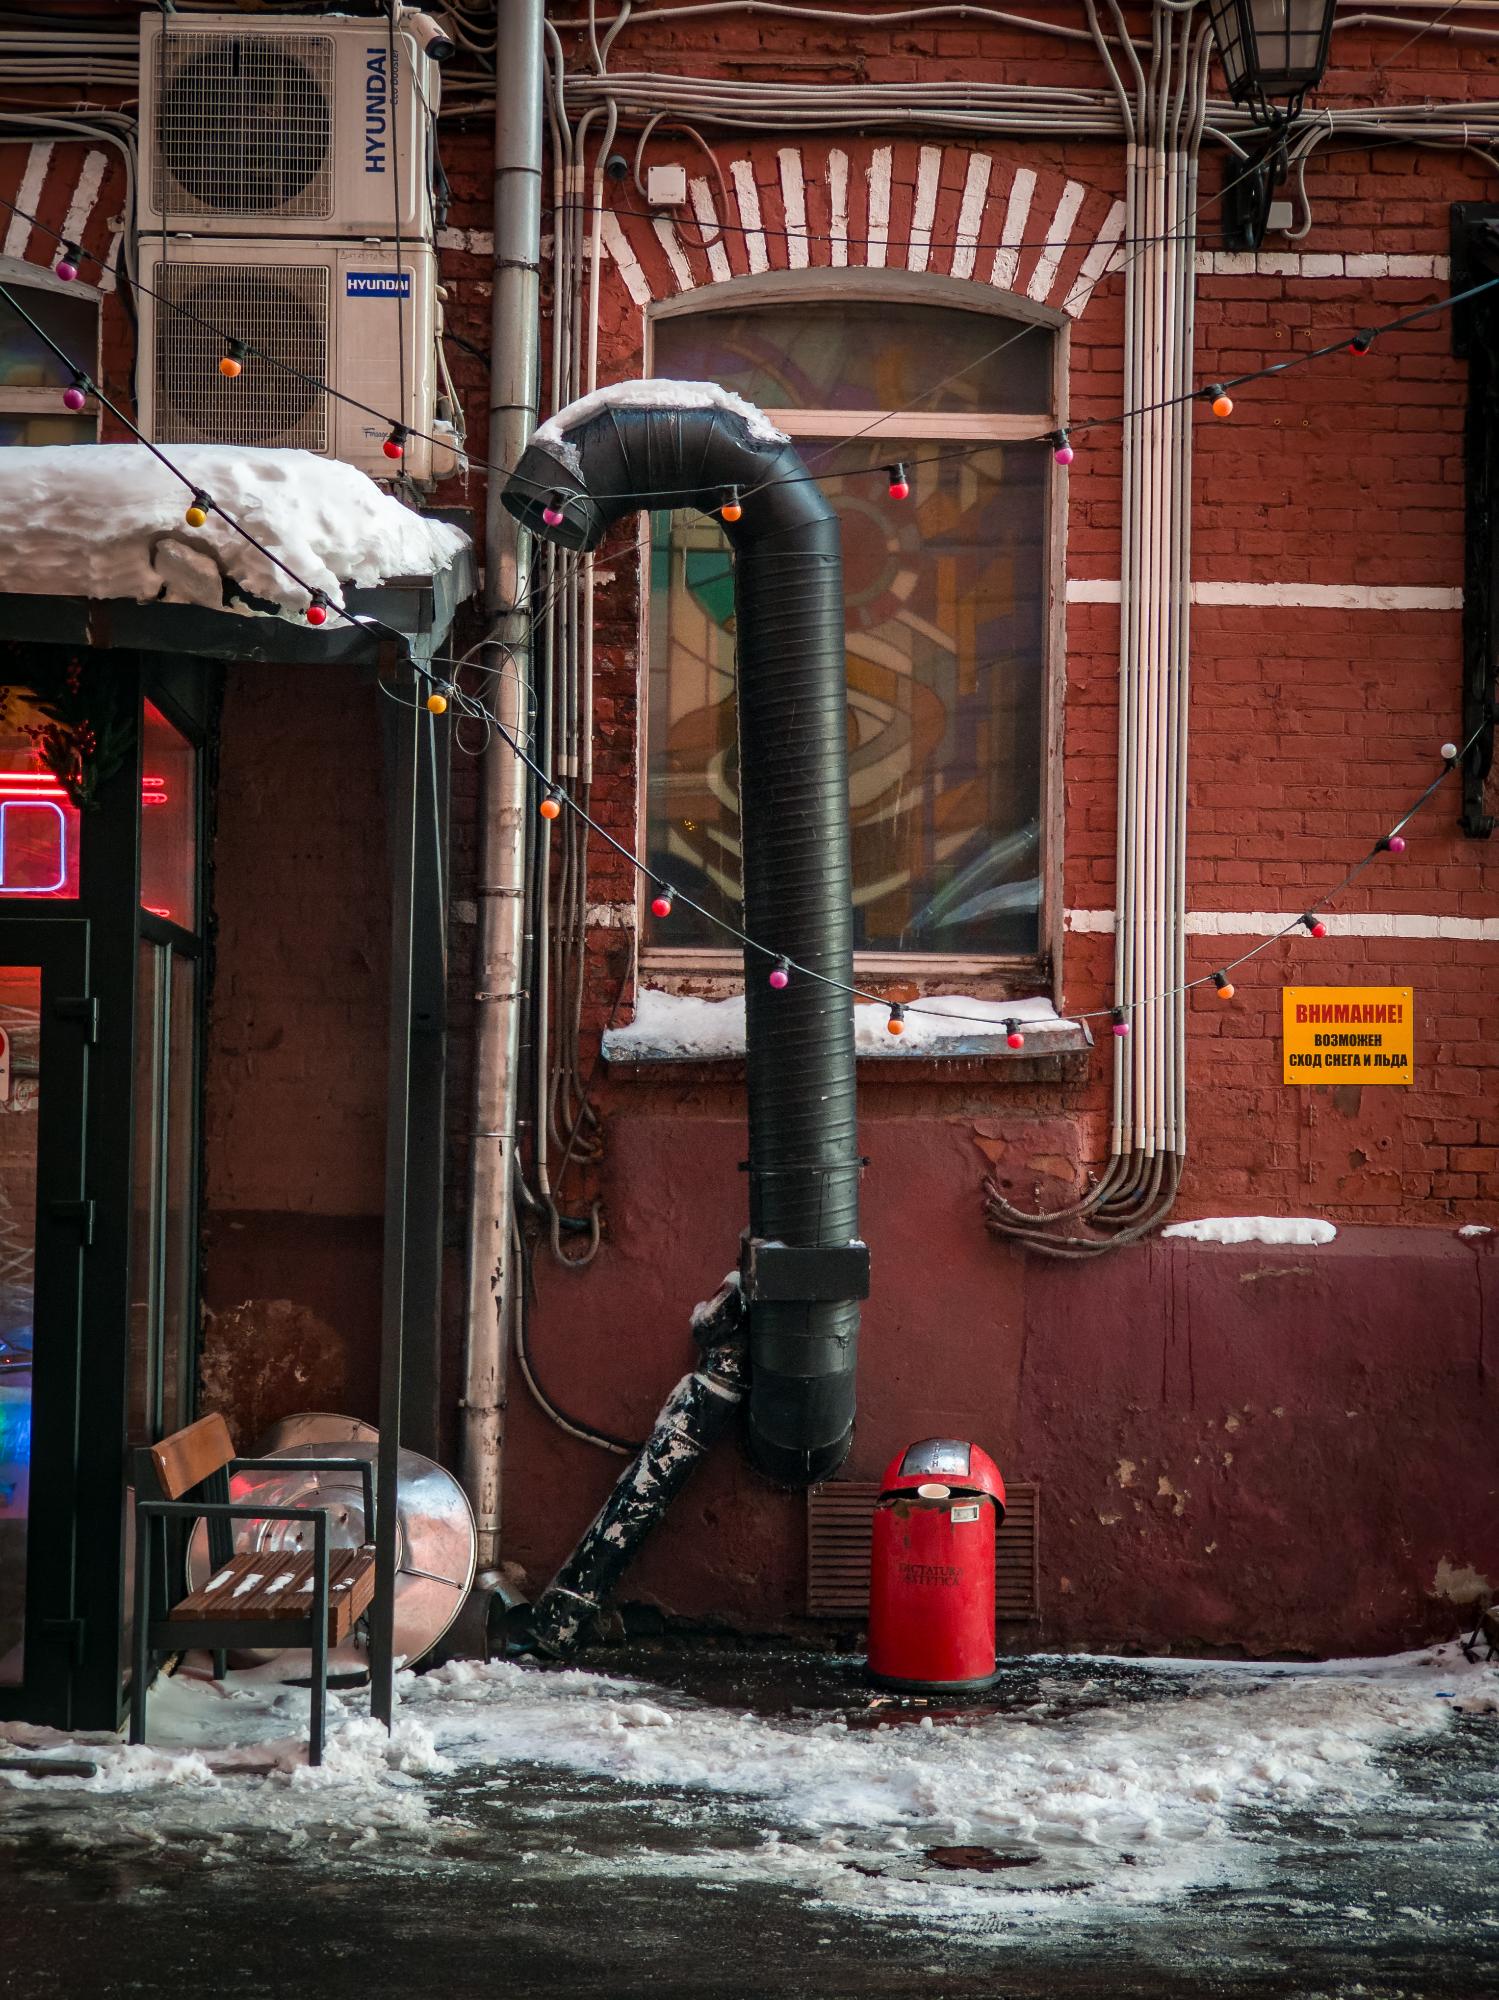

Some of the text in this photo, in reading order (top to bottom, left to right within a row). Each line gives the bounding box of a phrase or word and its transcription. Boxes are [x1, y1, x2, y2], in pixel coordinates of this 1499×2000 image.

[366, 48, 386, 172] HYUNDAI
[347, 279, 409, 290] HYUNDAI
[1296, 1004, 1403, 1024] ВНИМАНИЕ!
[1314, 1034, 1382, 1047] ВОЗМОЖЕН
[1289, 1054, 1408, 1068] СХОД СНЕГА И ЛЬДА
